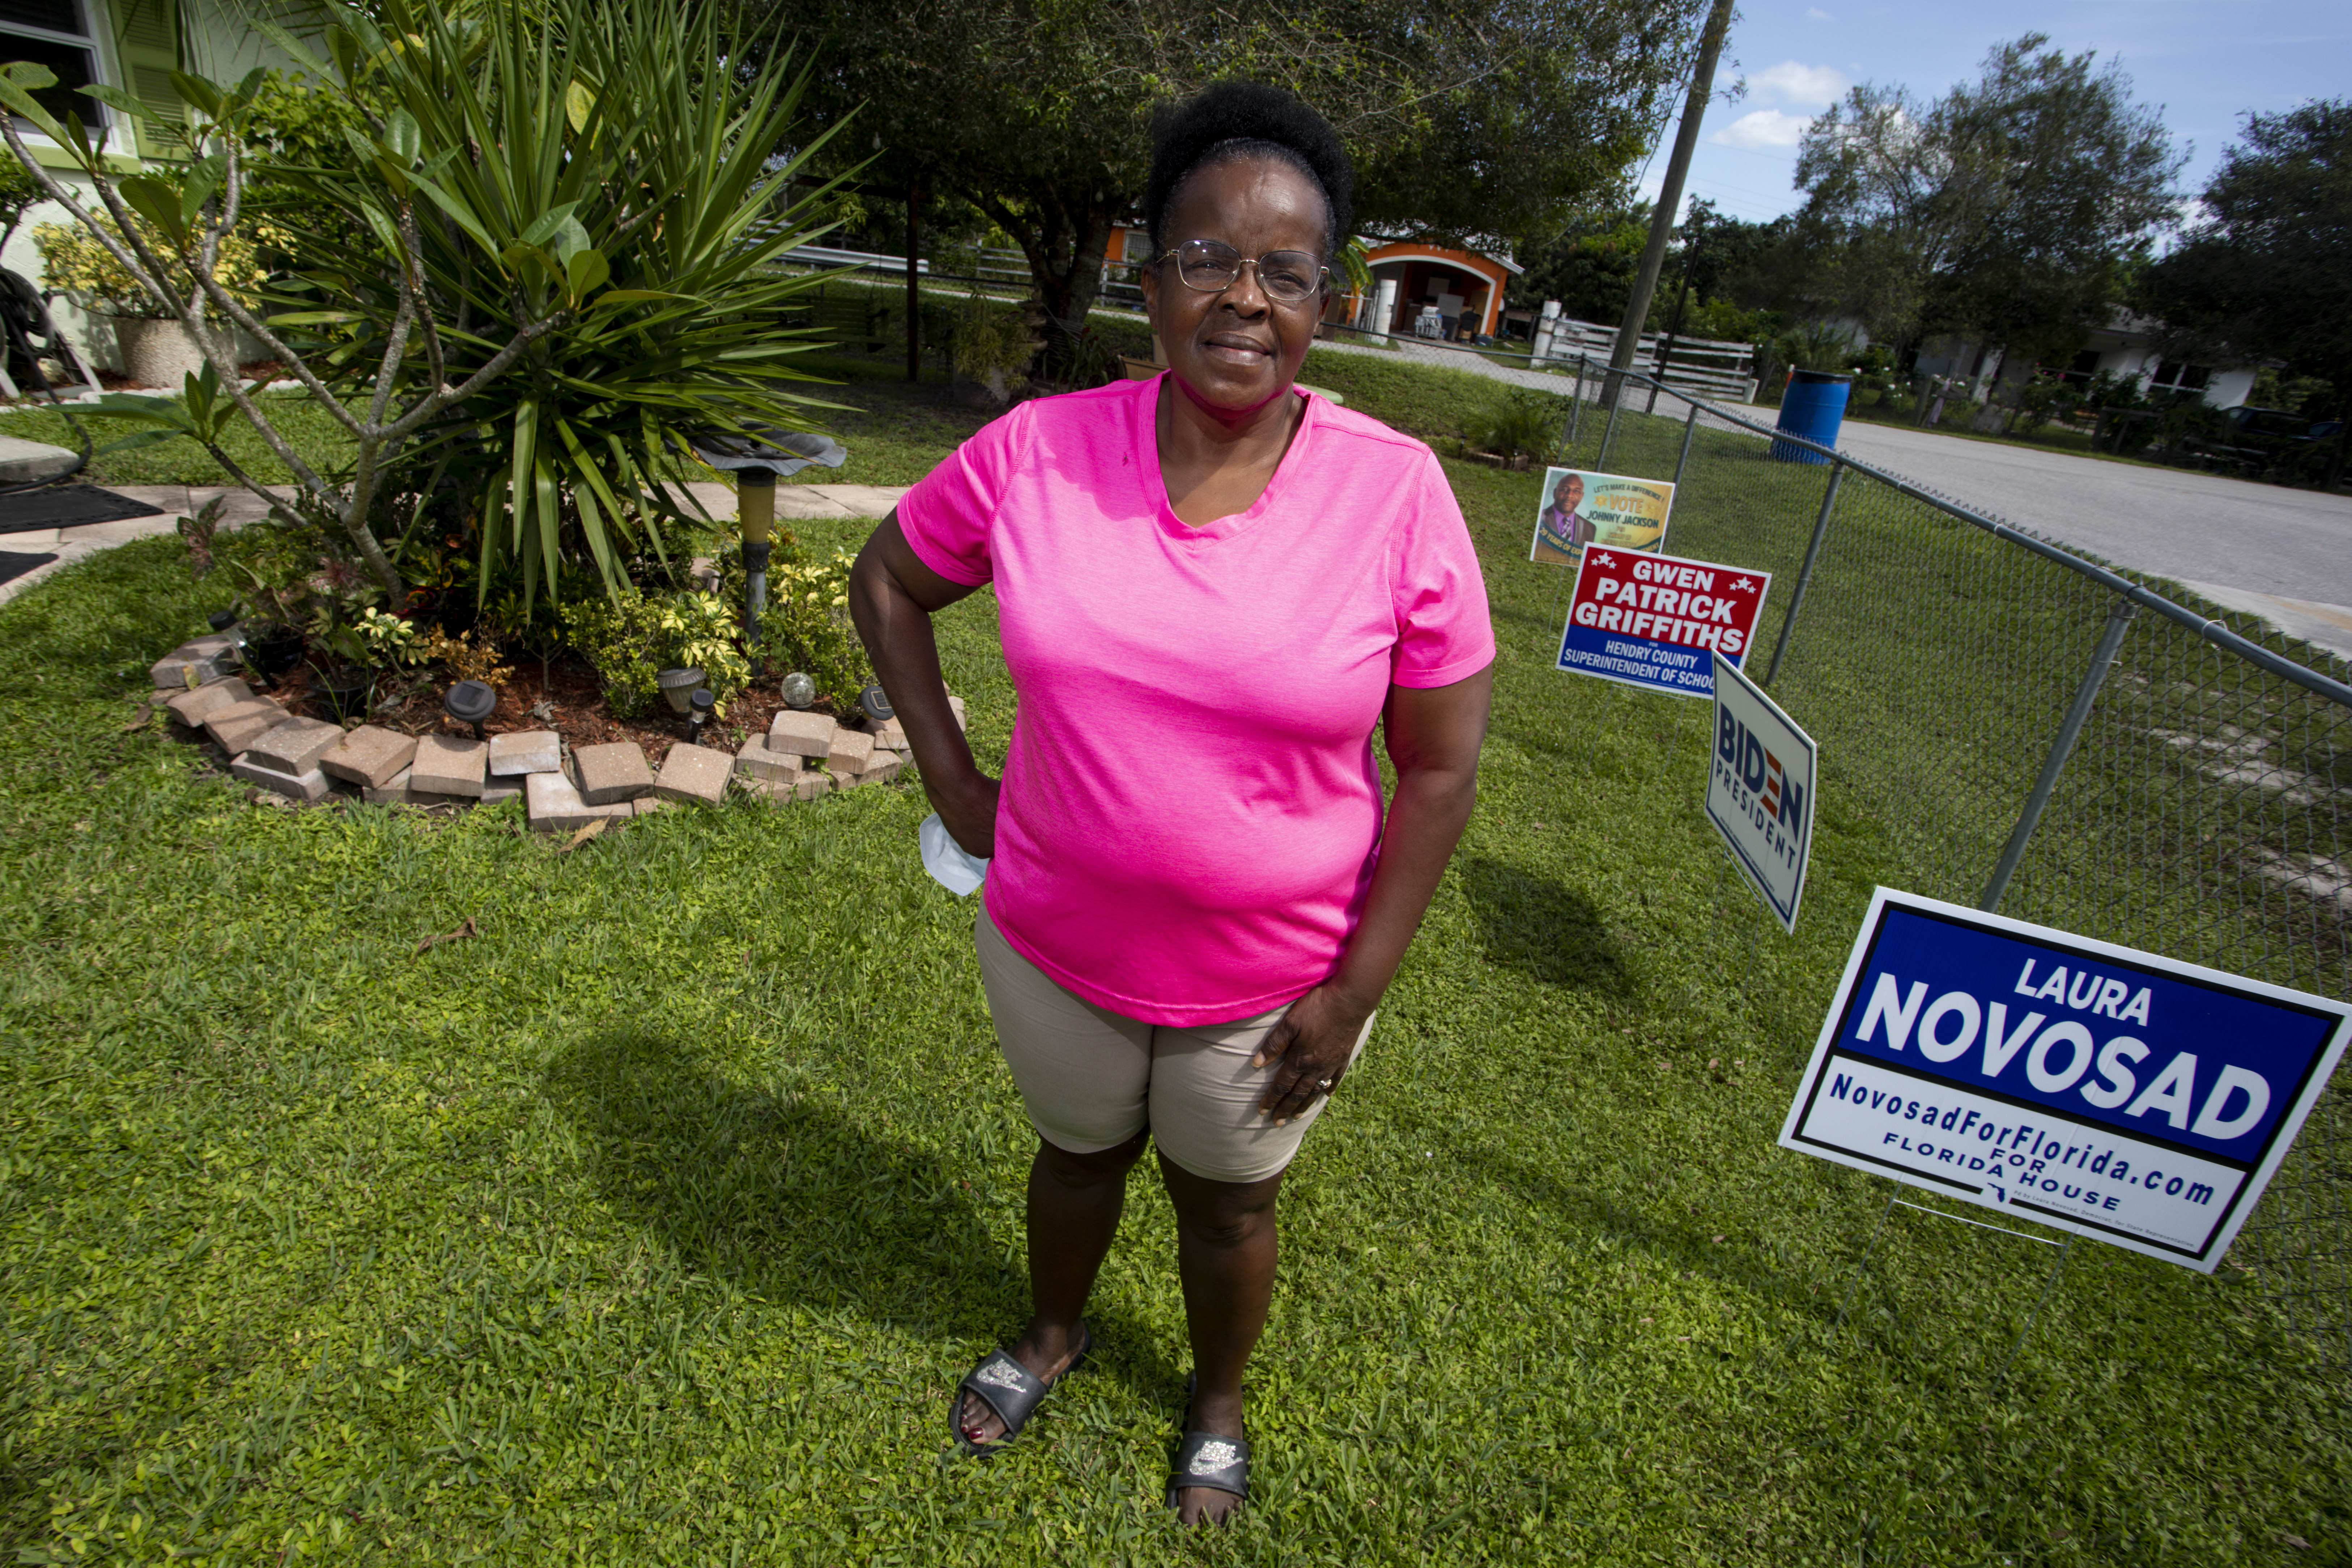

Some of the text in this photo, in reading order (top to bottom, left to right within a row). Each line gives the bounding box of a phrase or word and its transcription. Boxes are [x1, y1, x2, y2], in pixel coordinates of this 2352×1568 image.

[1610, 494, 1643, 514] VOTE
[1631, 485, 1662, 501] DIFFERENCE
[1586, 510, 1659, 528] JOHNNY JACKSON
[1547, 533, 1564, 547] YEARS
[1571, 547, 1583, 556] EXP
[1633, 560, 1715, 591] GWEN
[1595, 577, 1737, 624] PATRICK
[1575, 602, 1744, 652] GRIFFITHS
[1564, 649, 1661, 679] SUPERINTENDENT
[1661, 668, 1678, 682] OF
[1605, 640, 1698, 669] HENDRY COUNTY
[1718, 702, 1803, 844] BIDEN
[1716, 759, 1796, 869] PRESIDENT
[2014, 958, 2151, 1027] LAURA
[1855, 972, 2270, 1140] NOVOSAD
[1830, 1073, 2215, 1206] NovosadForFlorida.com
[1883, 1132, 2121, 1211] FLORIDA HOUSE
[1989, 1148, 2046, 1173] FOR
[2032, 1195, 2049, 1204] Laura
[2126, 1223, 2144, 1232] State
